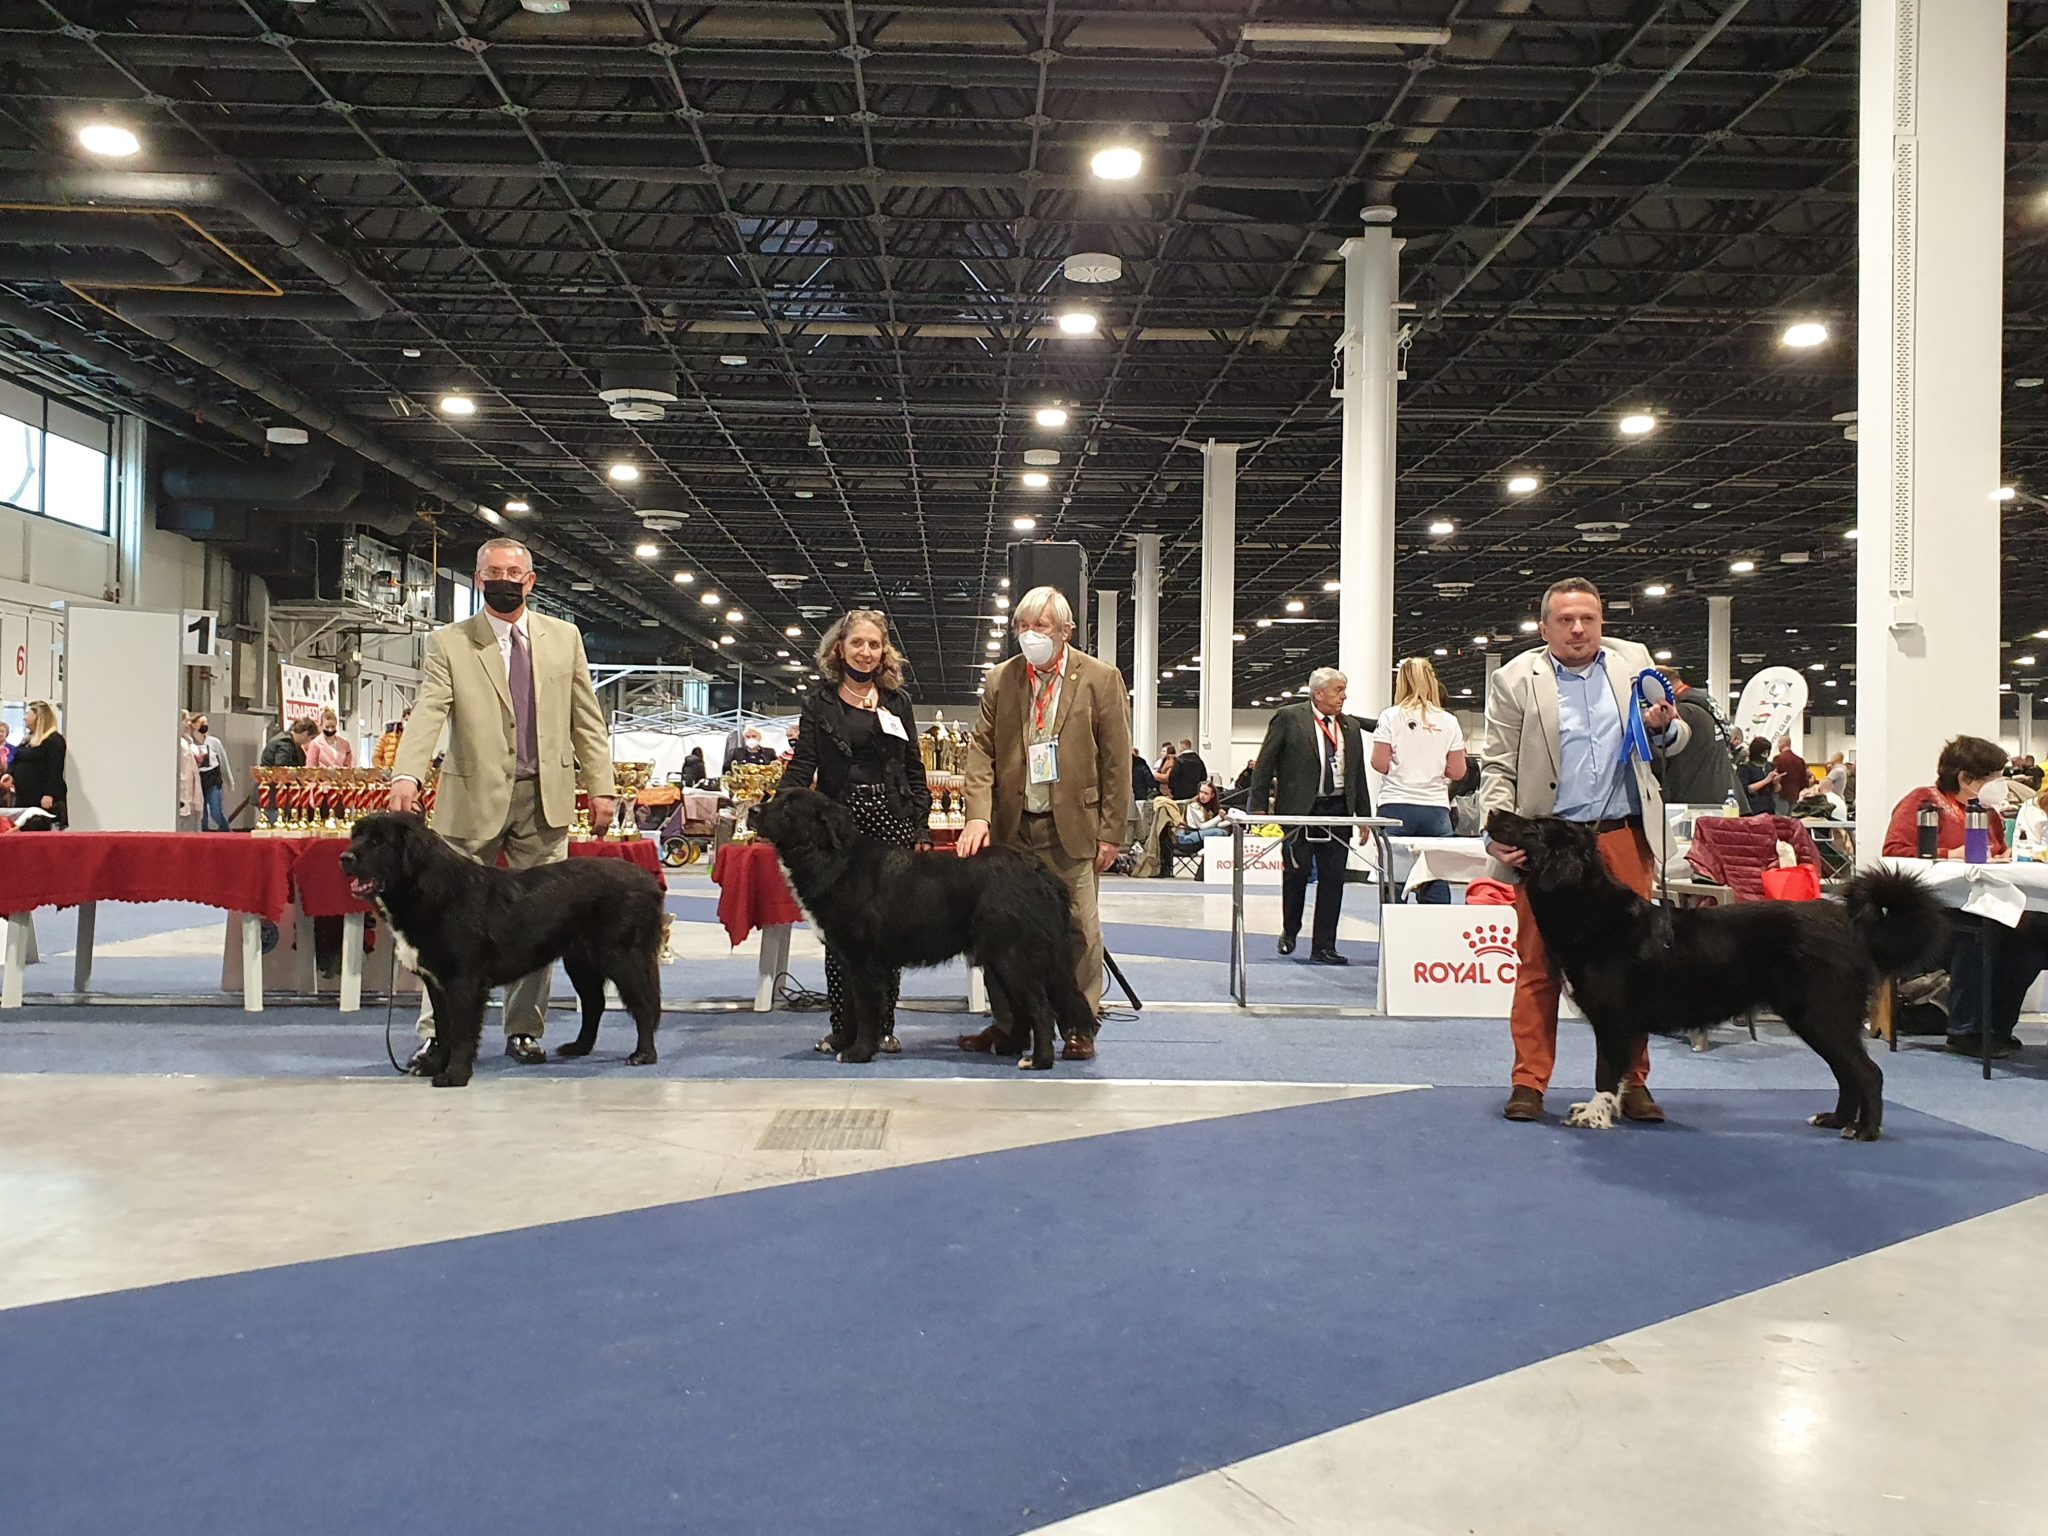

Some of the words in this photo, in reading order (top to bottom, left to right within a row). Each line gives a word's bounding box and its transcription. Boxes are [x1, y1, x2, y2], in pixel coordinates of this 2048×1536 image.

[188, 616, 210, 655] 1
[16, 645, 25, 676] 6
[1413, 961, 1491, 984] ROYAL
